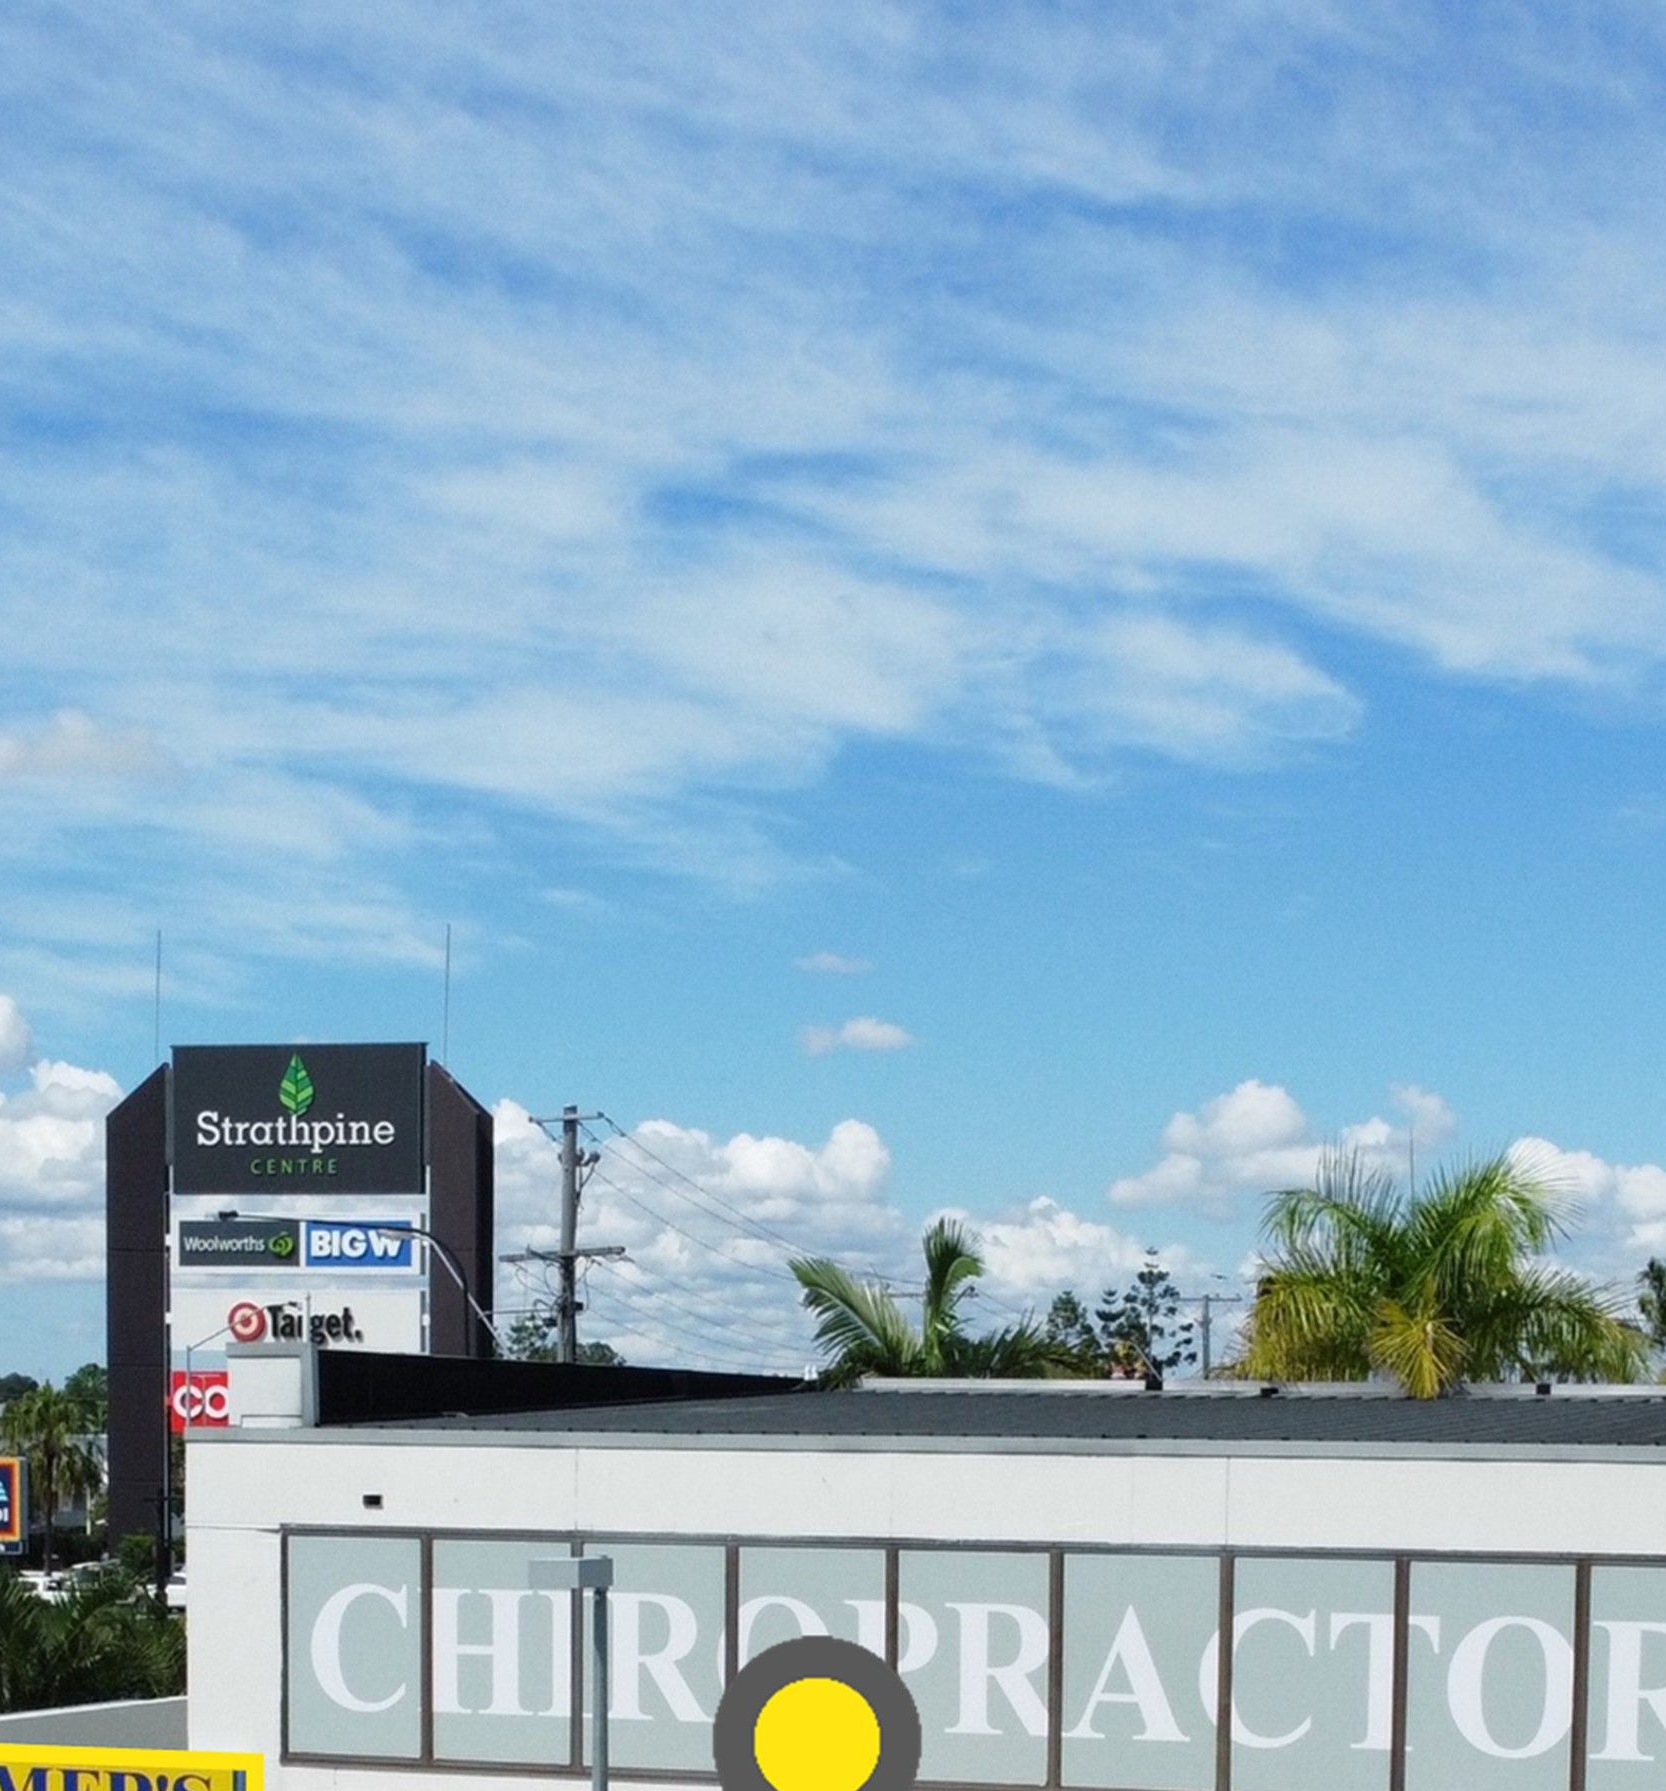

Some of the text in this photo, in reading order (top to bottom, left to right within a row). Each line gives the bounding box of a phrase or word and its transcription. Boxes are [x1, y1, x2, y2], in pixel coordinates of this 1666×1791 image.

[196, 1111, 396, 1153] Strathpine
[250, 1158, 338, 1175] CENTRE
[183, 1235, 265, 1252] Woolworths
